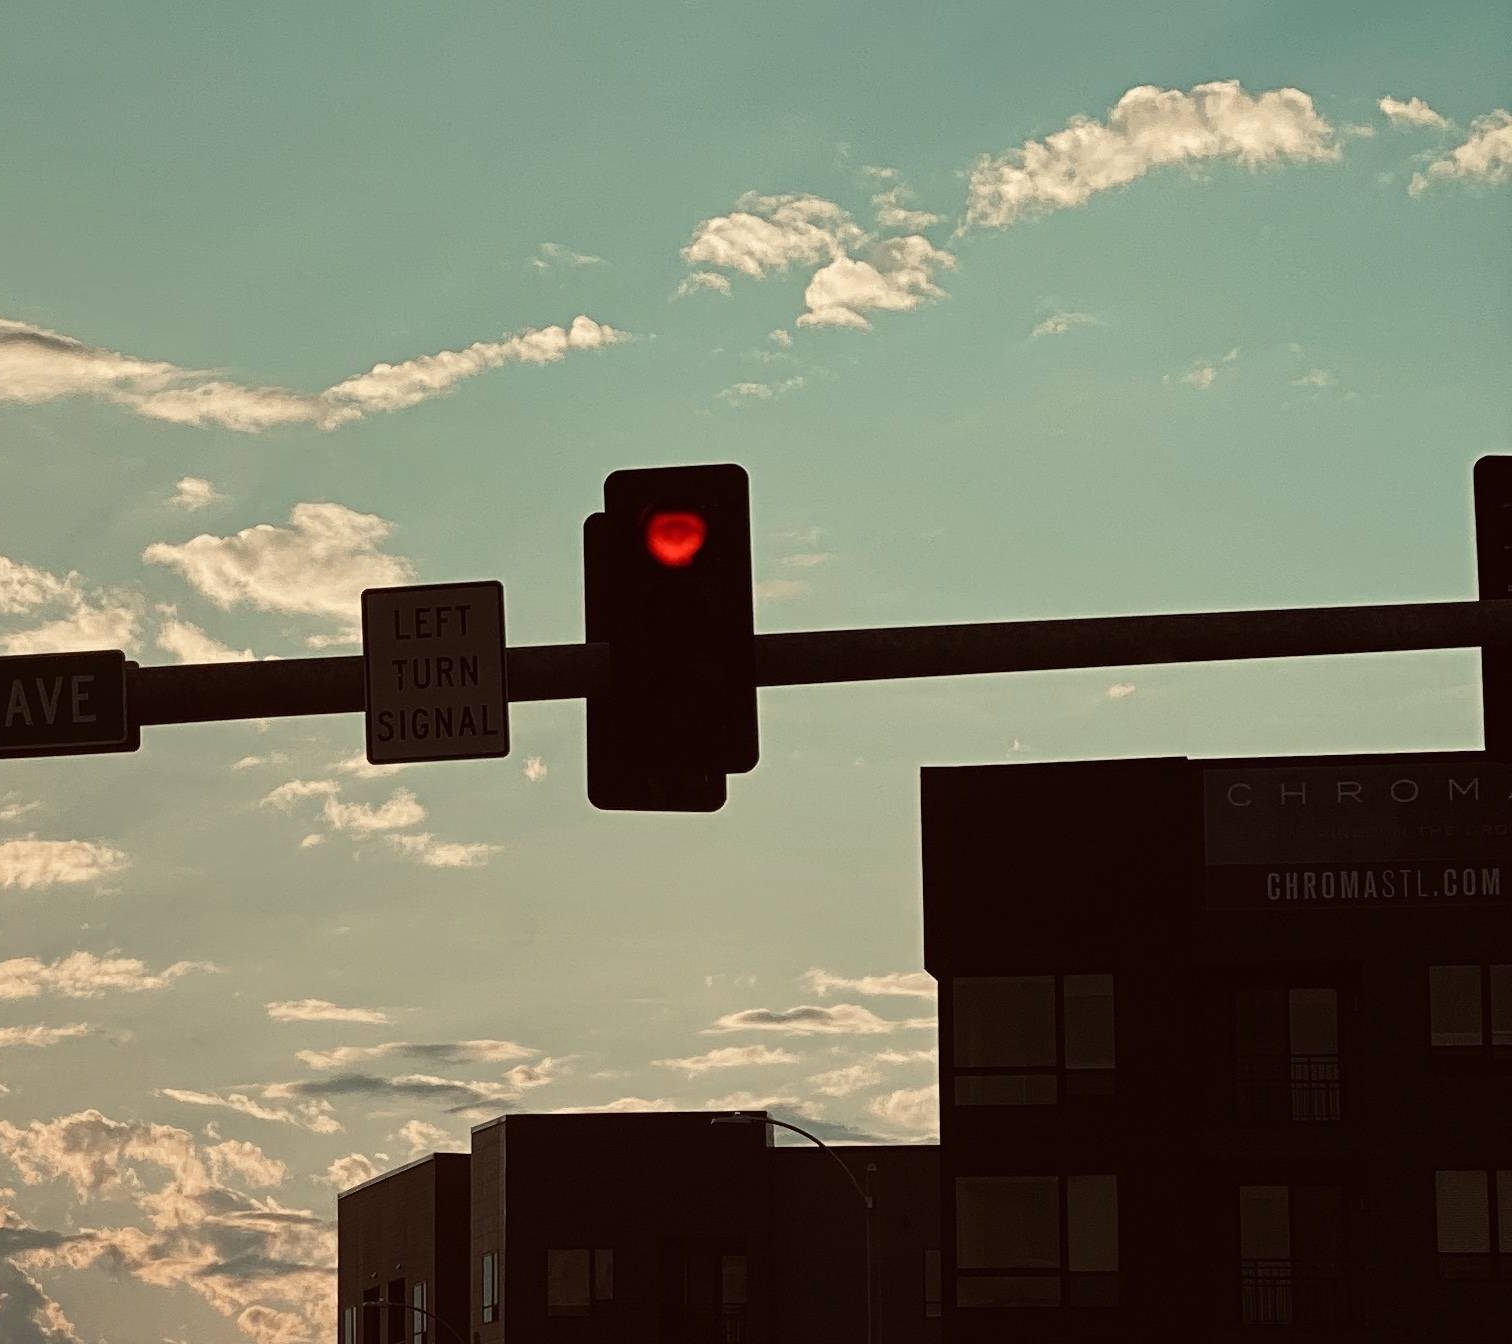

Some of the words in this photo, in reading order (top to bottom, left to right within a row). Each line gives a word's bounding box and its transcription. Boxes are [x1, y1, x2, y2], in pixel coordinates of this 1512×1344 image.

[394, 605, 471, 640] LEFT
[392, 656, 479, 691] TURN
[4, 674, 98, 729] AVE
[377, 704, 499, 742] SIGNAL
[1226, 776, 1512, 806] CHROM
[1266, 867, 1502, 900] CHROMASTL.COM
